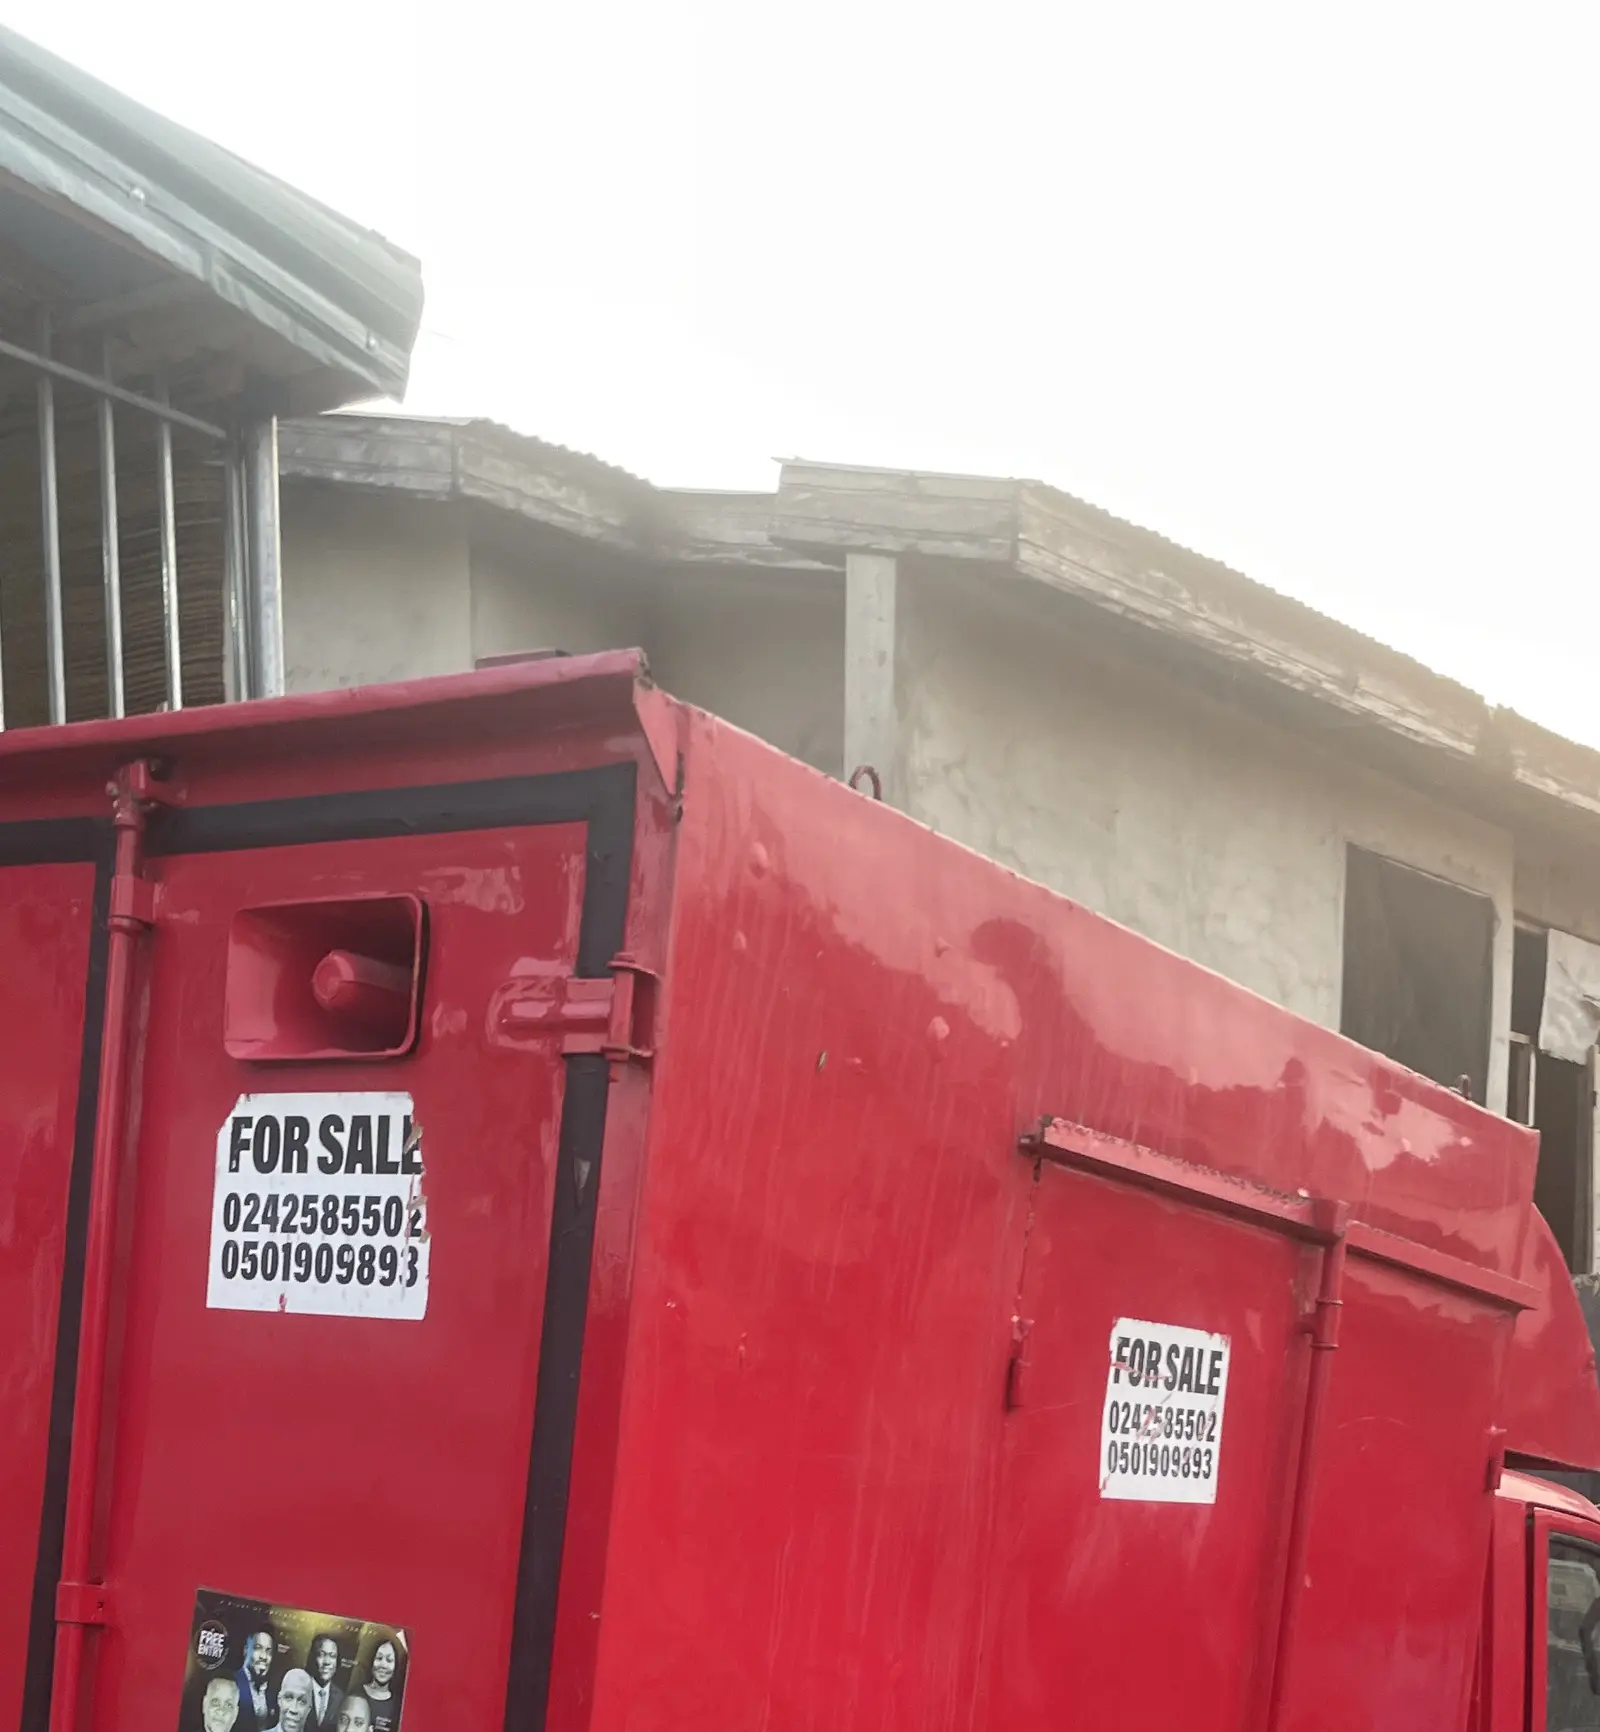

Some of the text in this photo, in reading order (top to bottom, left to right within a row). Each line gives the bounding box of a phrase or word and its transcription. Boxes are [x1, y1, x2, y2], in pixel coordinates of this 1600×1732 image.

[228, 1115, 310, 1174] FOR
[221, 1239, 418, 1288] 0501909893
[1113, 1336, 1223, 1396] FOR SALE
[1108, 1440, 1213, 1479] 0501909893
[197, 1643, 224, 1659] ENTRY
[199, 1630, 225, 1648] FREE
